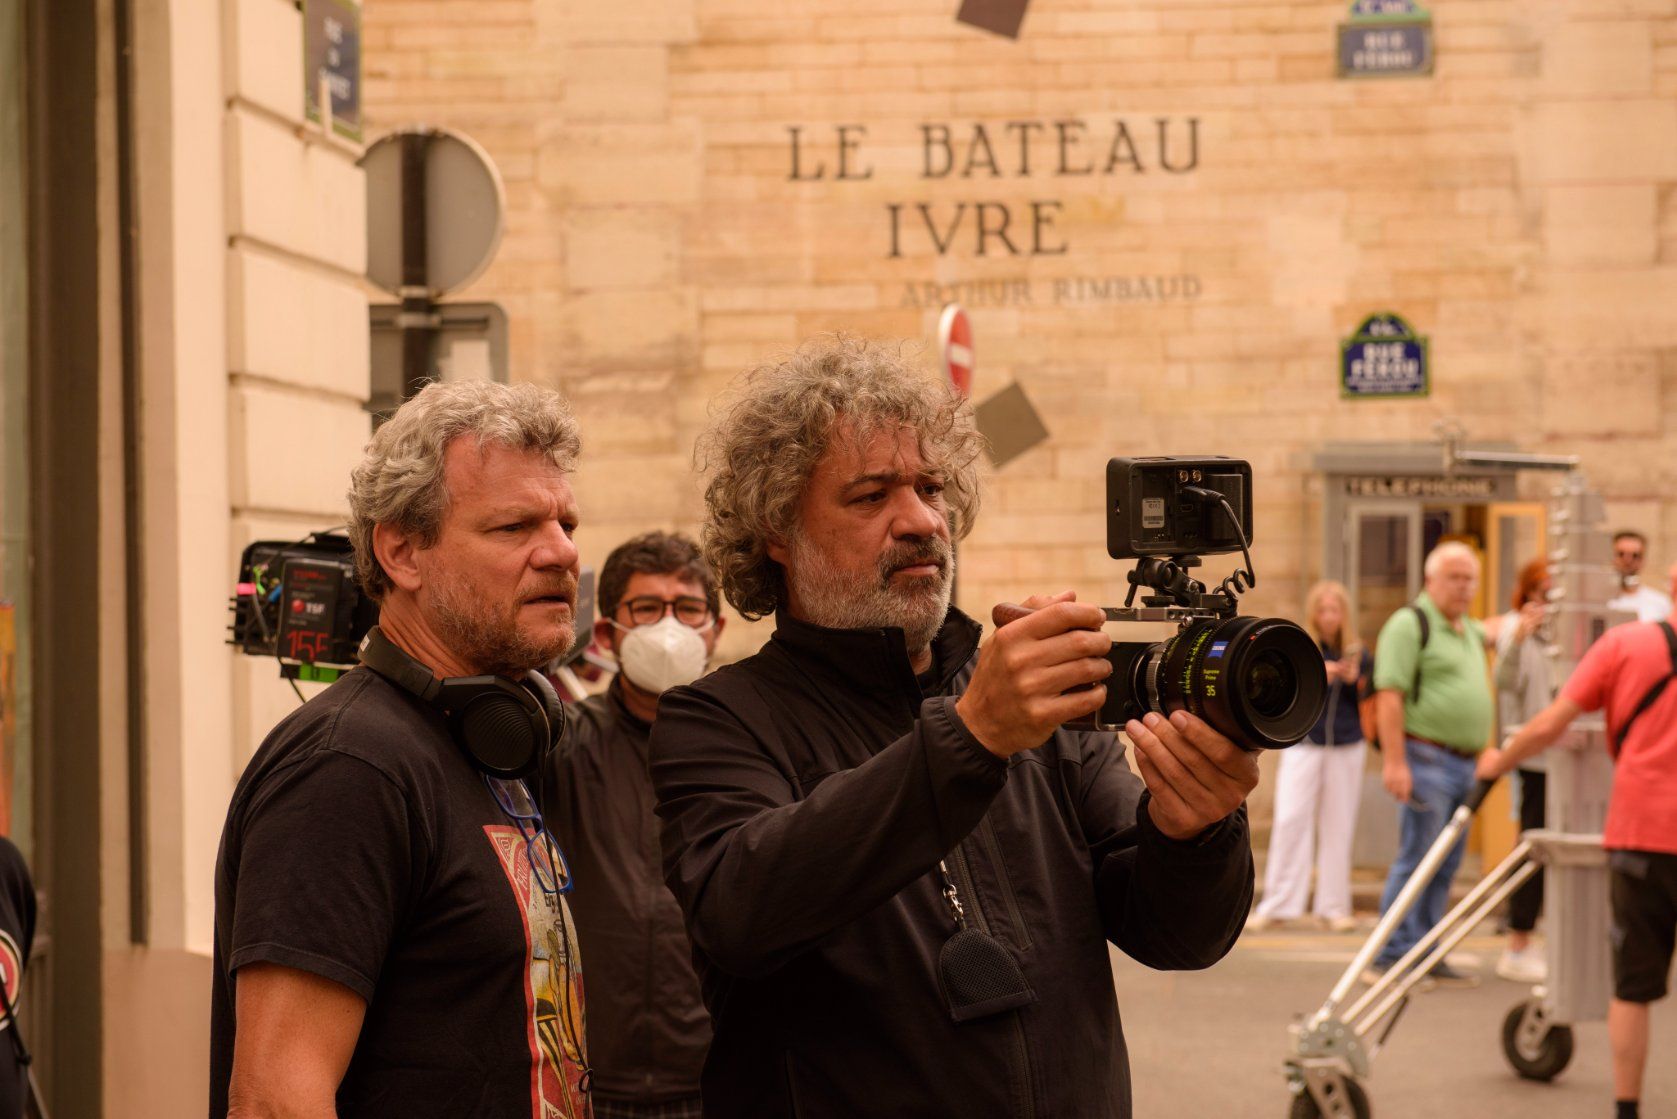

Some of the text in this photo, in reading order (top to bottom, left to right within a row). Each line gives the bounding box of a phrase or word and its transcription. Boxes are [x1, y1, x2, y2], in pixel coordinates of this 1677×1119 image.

[787, 117, 1201, 181] LE BATEAU
[886, 200, 1068, 259] IVRE
[900, 273, 1204, 308] ARTHUR RIMBAUD
[1206, 685, 1216, 697] 35
